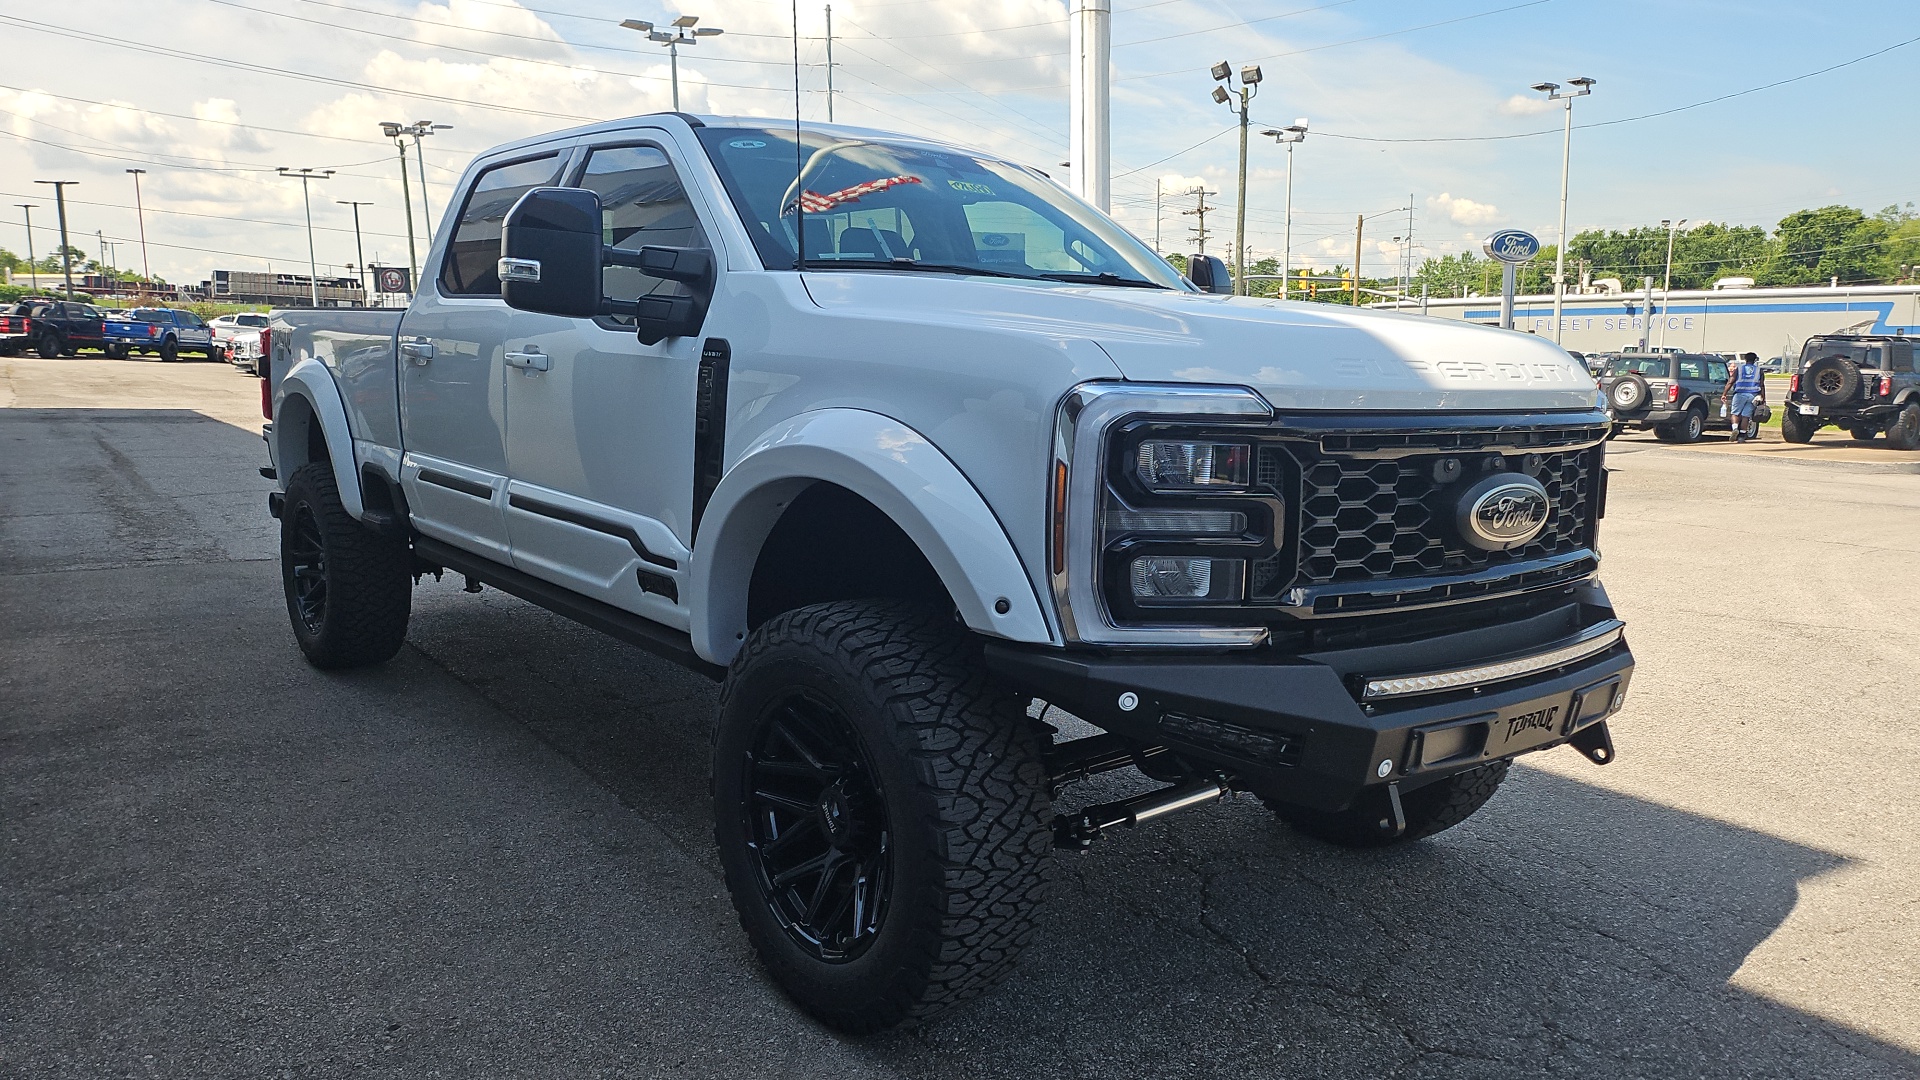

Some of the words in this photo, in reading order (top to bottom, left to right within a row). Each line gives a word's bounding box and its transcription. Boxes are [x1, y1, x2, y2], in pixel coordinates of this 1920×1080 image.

[1501, 235, 1532, 256] Ford
[1535, 318, 1594, 331] FLEET
[1335, 358, 1497, 381] SUPER
[1496, 362, 1578, 382] DUTY
[1492, 496, 1537, 529] Ford
[1503, 705, 1560, 744] TORQUE
